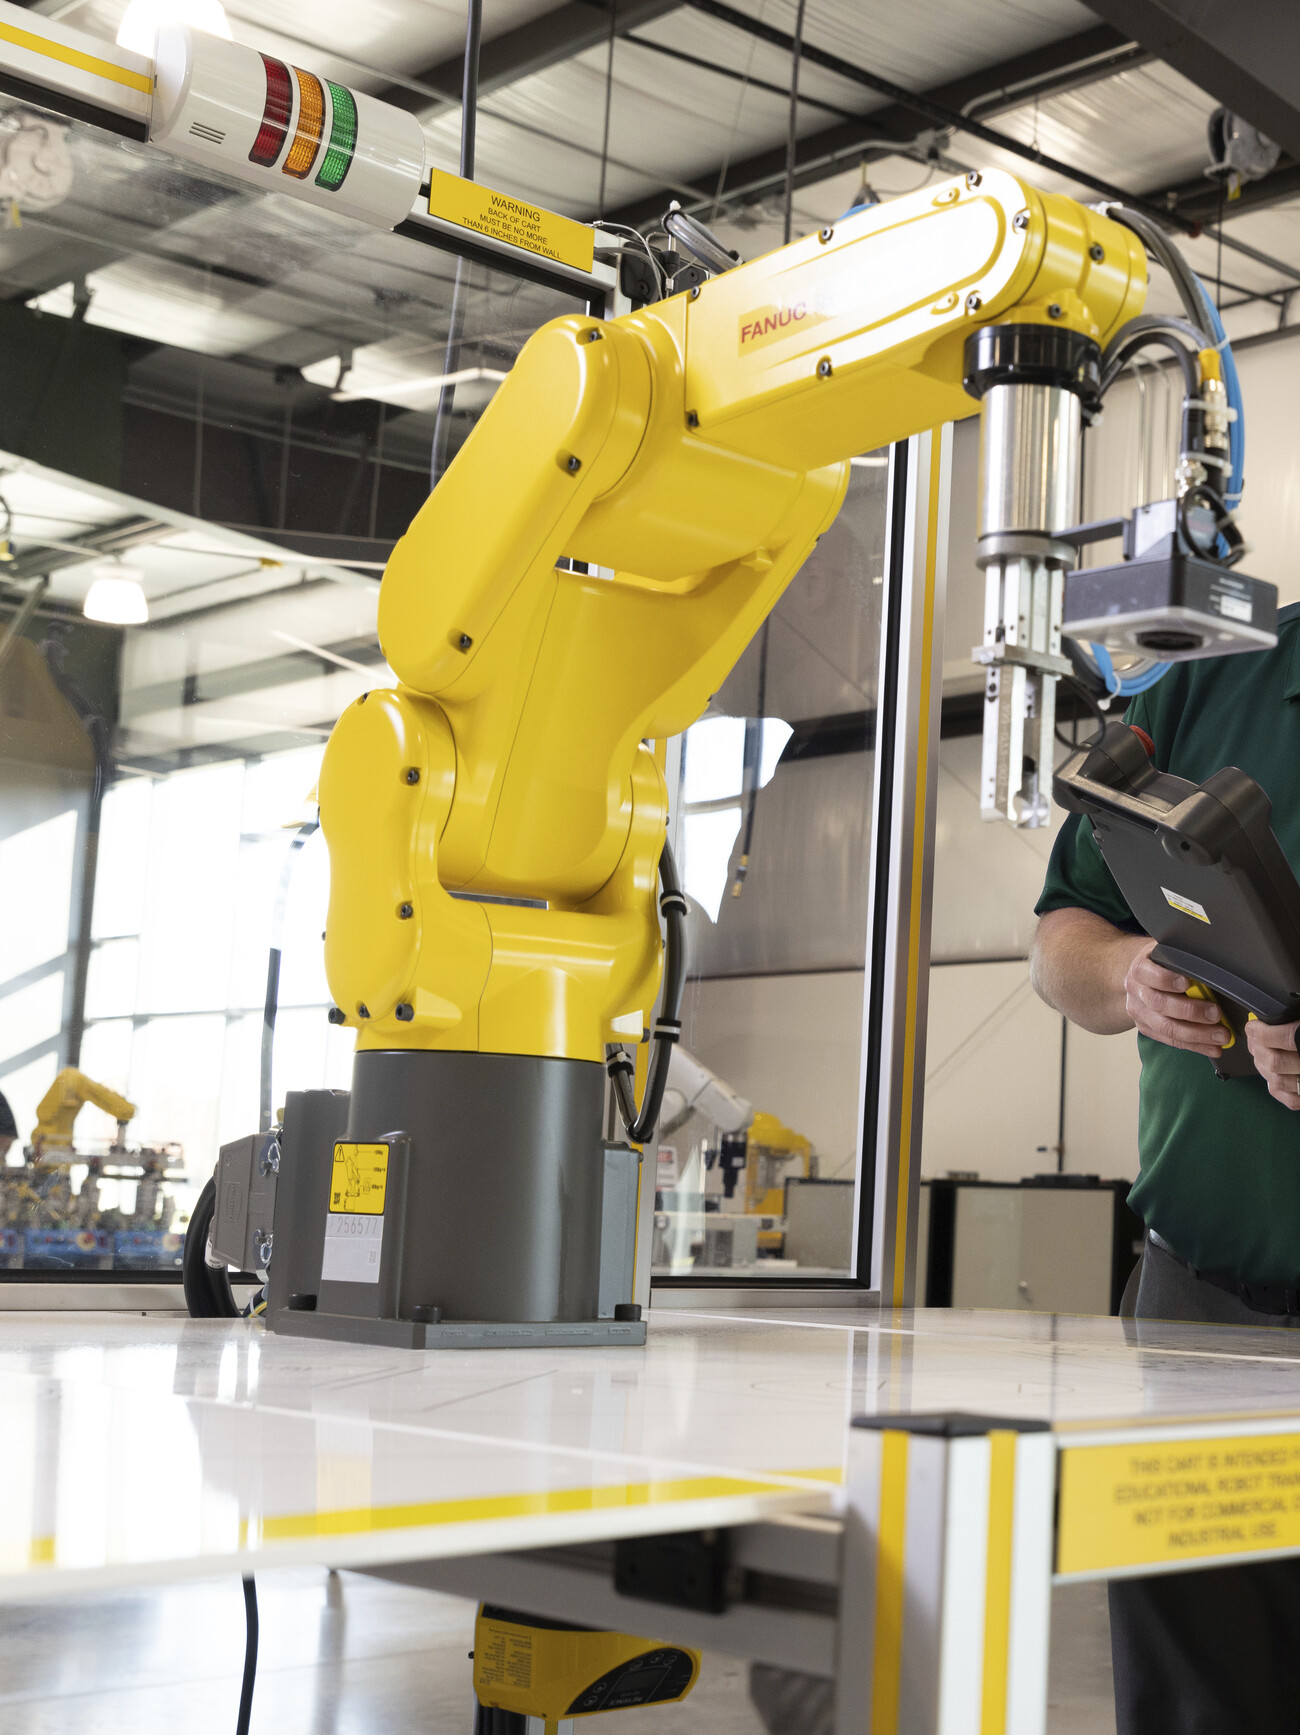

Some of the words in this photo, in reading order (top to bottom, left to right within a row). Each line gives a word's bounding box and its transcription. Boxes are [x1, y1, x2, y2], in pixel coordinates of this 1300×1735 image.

[487, 207, 508, 221] BACK
[509, 215, 520, 223] OF
[521, 219, 541, 233] CART
[491, 195, 541, 222] WARNING
[462, 216, 483, 230] THAN
[490, 227, 518, 243] INCHES
[519, 237, 541, 252] FROM
[479, 214, 500, 227] MUST
[502, 222, 512, 232] BE
[513, 226, 525, 236] NO
[526, 231, 548, 245] MORE
[741, 301, 807, 344] FANUC
[1131, 1457, 1160, 1475] THIS
[1168, 1453, 1201, 1473] CART
[1224, 1447, 1287, 1469] INTENDED
[1114, 1479, 1210, 1504] EDUCATIONAL
